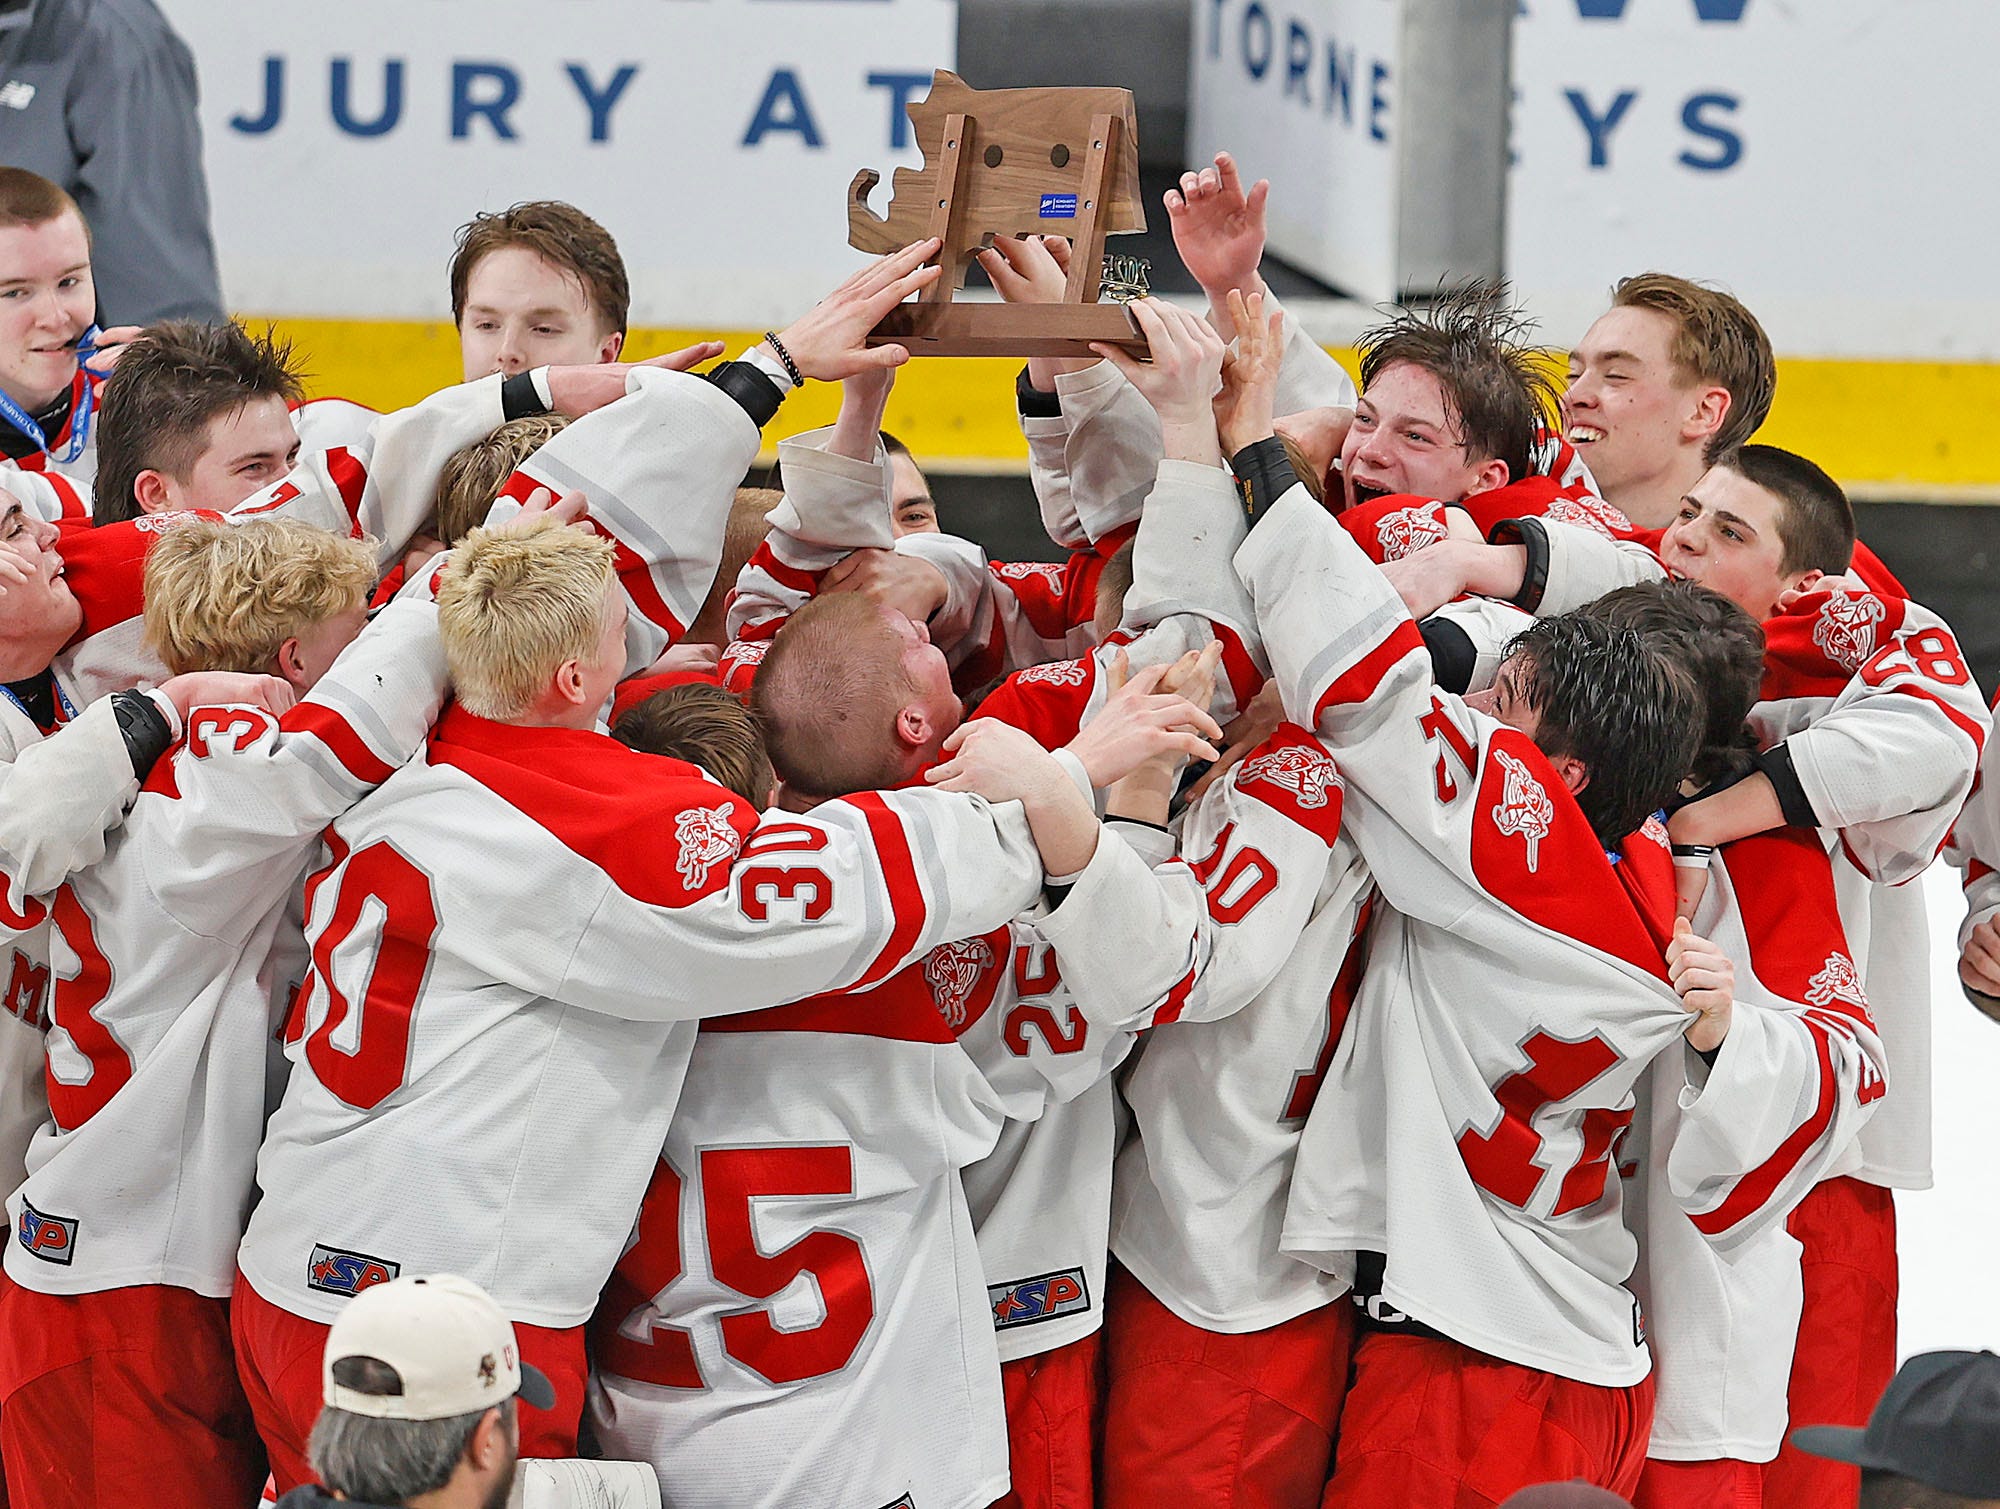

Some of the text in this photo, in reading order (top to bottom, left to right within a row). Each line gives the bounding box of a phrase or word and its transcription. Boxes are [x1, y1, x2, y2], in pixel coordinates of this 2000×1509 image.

[229, 55, 639, 143] JURY
[1508, 89, 1743, 171] YS
[187, 705, 272, 761] 3
[735, 821, 834, 923] 30
[322, 1255, 391, 1293] SP
[1008, 1275, 1083, 1321] SP
